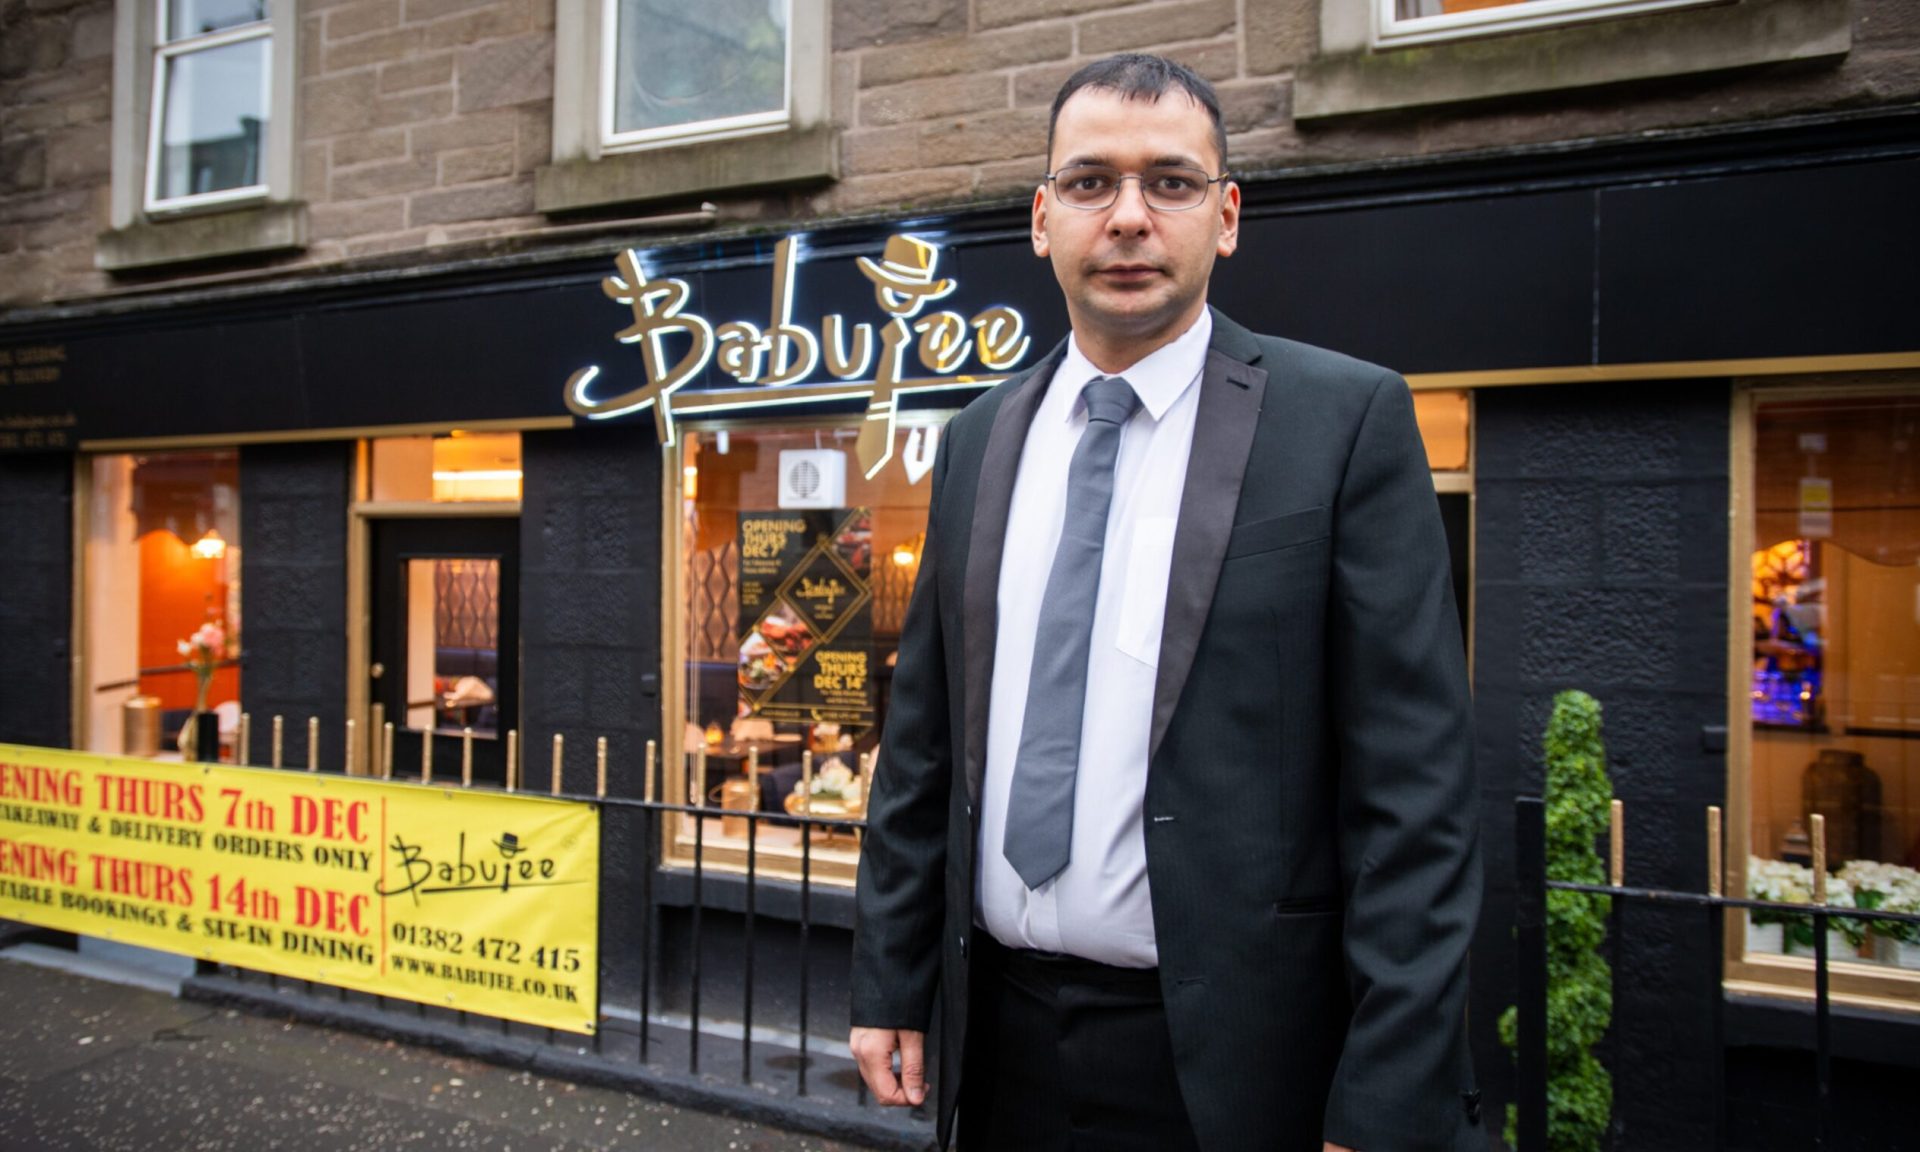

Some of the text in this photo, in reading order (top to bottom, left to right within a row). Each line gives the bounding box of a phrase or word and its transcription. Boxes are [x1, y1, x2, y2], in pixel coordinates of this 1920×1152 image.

[564, 235, 1030, 478] Babujee
[742, 519, 807, 533] OPENING
[743, 531, 787, 546] THURS
[742, 544, 769, 558] DEC
[815, 651, 867, 664] OPENING
[820, 662, 867, 677] THURS
[814, 675, 842, 690] DEC
[94, 774, 205, 823] THURS
[219, 788, 275, 833] 7th
[290, 794, 369, 844] DEC
[88, 816, 102, 834] &
[110, 818, 203, 850] DELIVERY
[214, 833, 304, 862] ORDERS
[314, 845, 373, 872] ONLY
[374, 831, 558, 908] Babujee
[89, 854, 194, 907] THURS
[208, 873, 280, 922] 14th
[294, 886, 370, 938] DEC
[61, 892, 168, 928] BOOKINGS
[177, 914, 192, 932] &
[203, 919, 271, 945] SIT-IN
[283, 931, 374, 966] DINING
[392, 922, 580, 973] 01382 472 415
[391, 955, 578, 1003] WWW.BABUJEE.CO.UK
